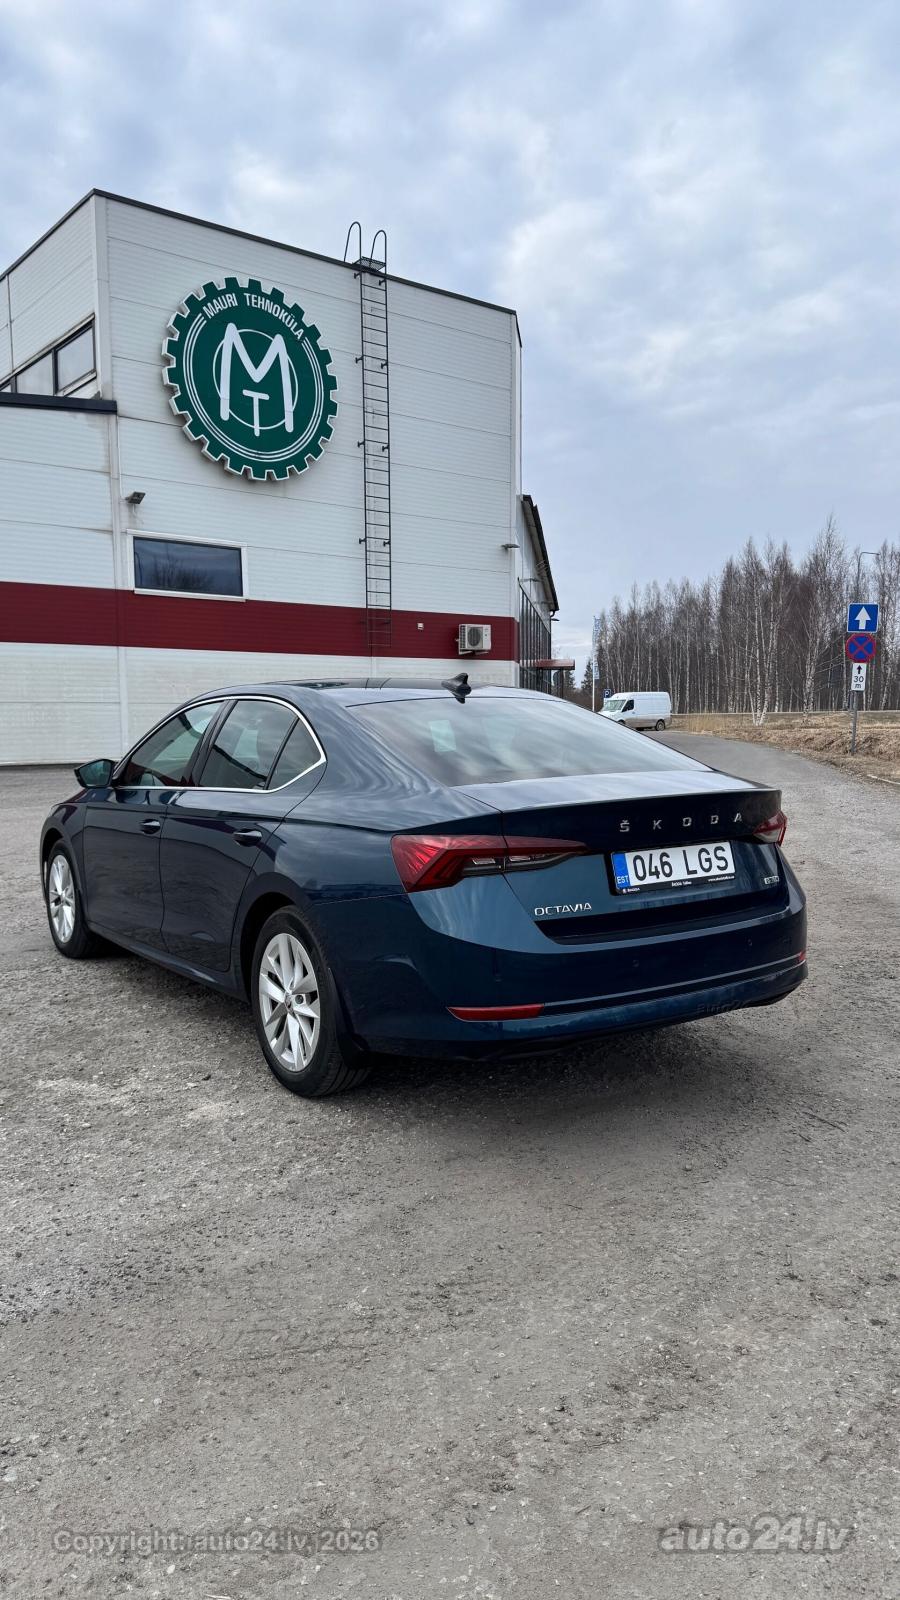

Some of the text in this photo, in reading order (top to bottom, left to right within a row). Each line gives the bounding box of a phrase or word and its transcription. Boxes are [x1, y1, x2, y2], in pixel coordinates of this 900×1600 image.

[202, 292, 306, 341] MAURI TEHNOKÜLA
[219, 322, 294, 433] M
[242, 389, 270, 437] T
[853, 675, 865, 684] 30
[619, 812, 744, 833] ŠKODA
[632, 845, 730, 882] 046 LGS
[616, 875, 630, 885] EST
[534, 902, 593, 916] OCTAVIA
